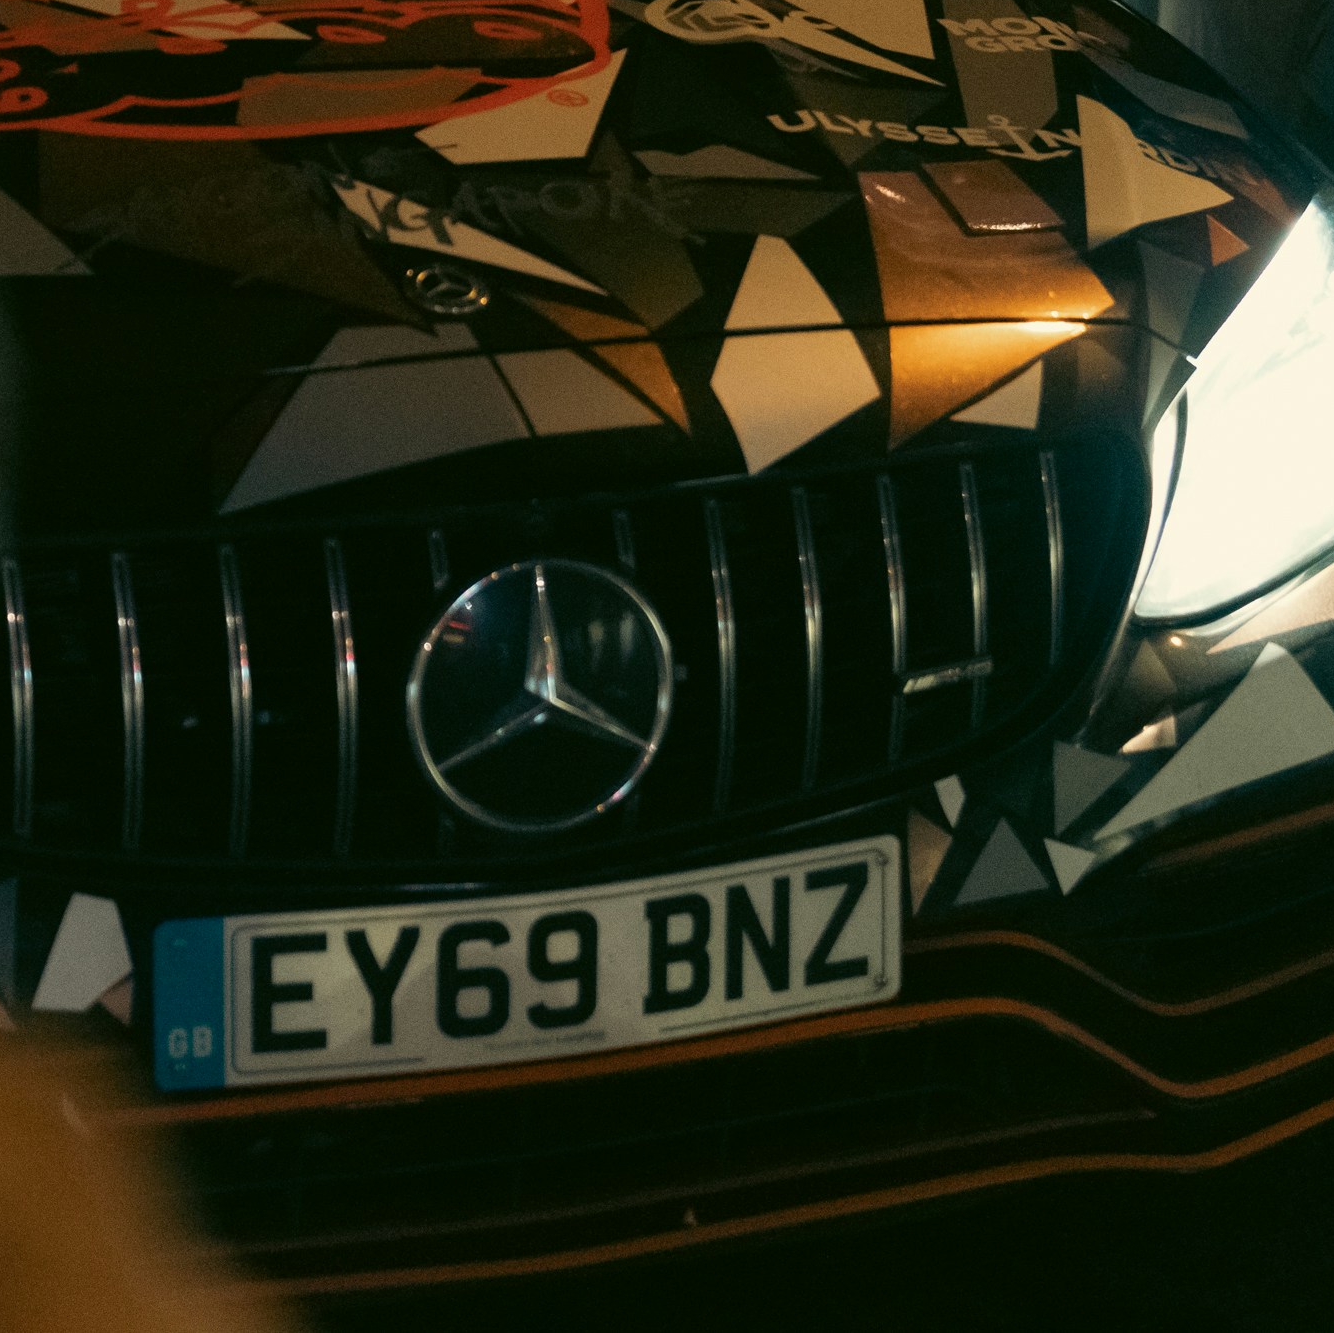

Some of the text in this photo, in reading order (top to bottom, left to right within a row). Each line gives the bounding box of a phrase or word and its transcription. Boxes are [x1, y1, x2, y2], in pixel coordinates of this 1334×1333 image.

[767, 109, 1000, 148] ULYSSE
[252, 862, 869, 1054] EY69 BNZ
[167, 1026, 214, 1059] GB
